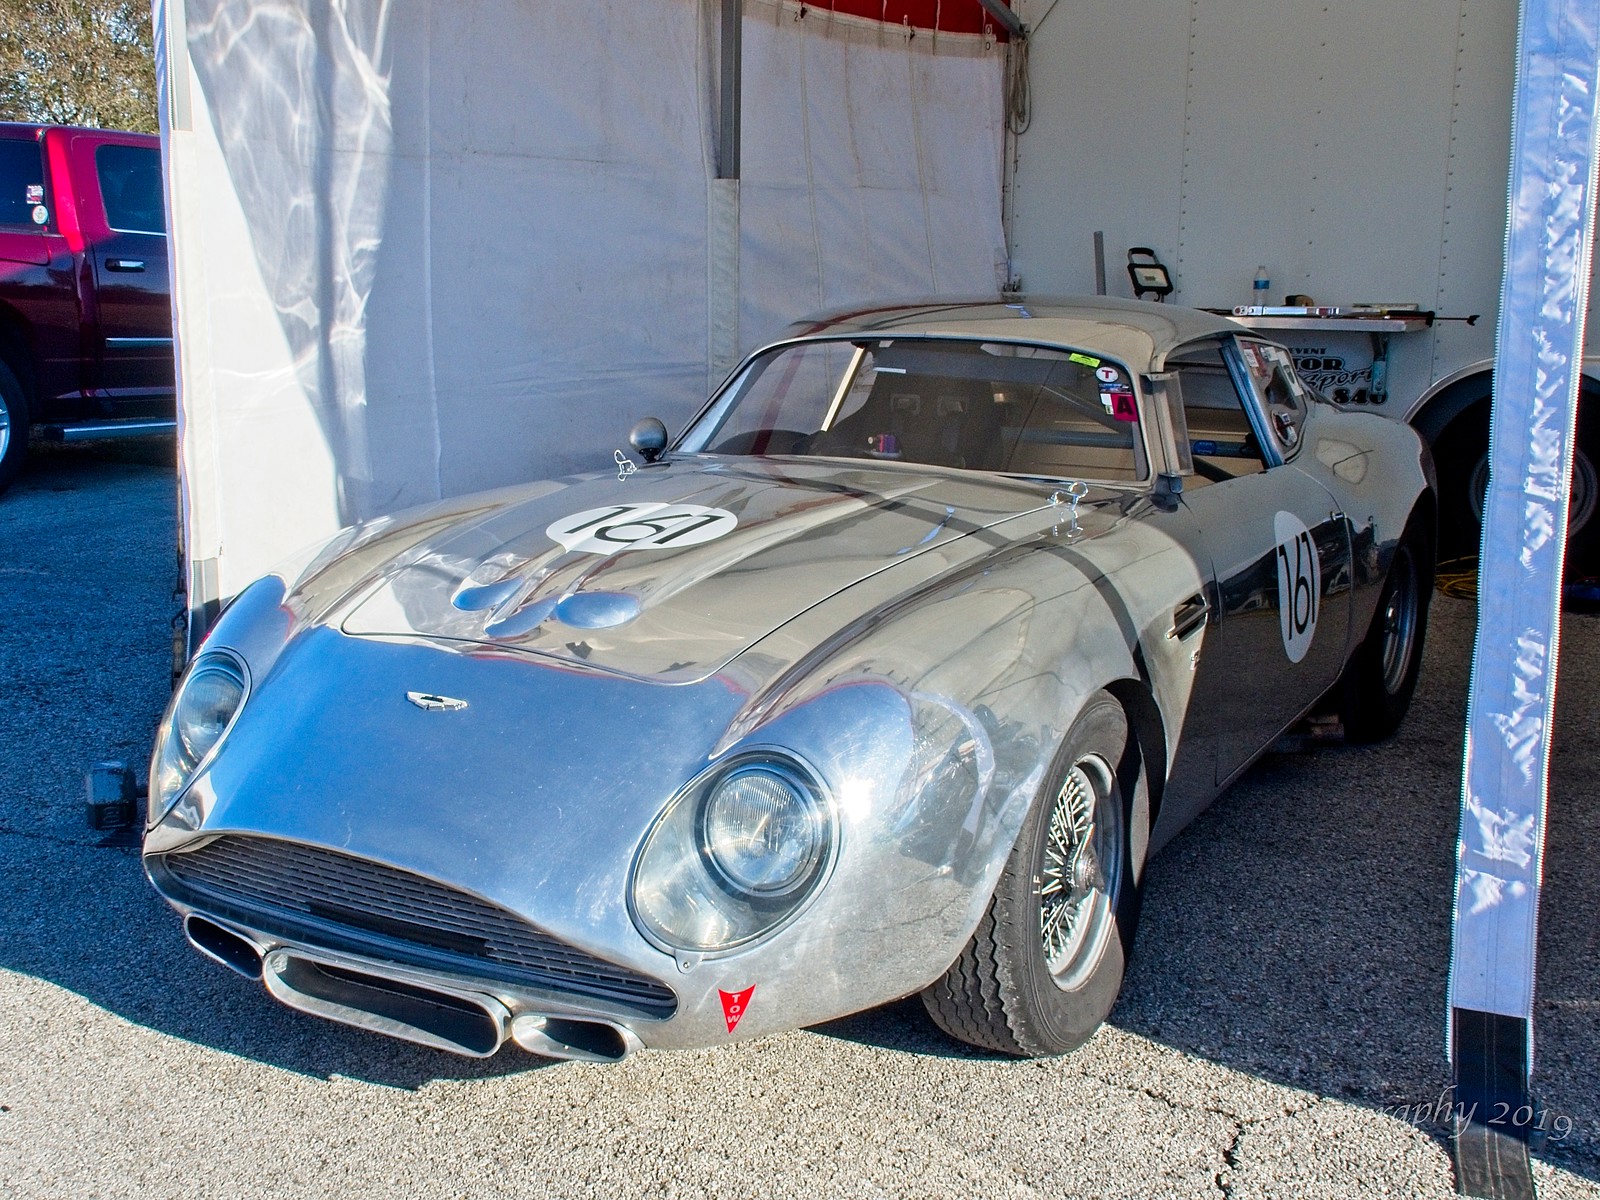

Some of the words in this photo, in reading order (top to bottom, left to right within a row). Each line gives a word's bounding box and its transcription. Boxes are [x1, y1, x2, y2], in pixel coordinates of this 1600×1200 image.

[1102, 369, 1113, 379] T
[1117, 396, 1134, 415] A
[563, 506, 726, 546] 161
[1278, 531, 1315, 641] 161
[1032, 875, 1041, 894] LF
[727, 994, 741, 1023] TOW
